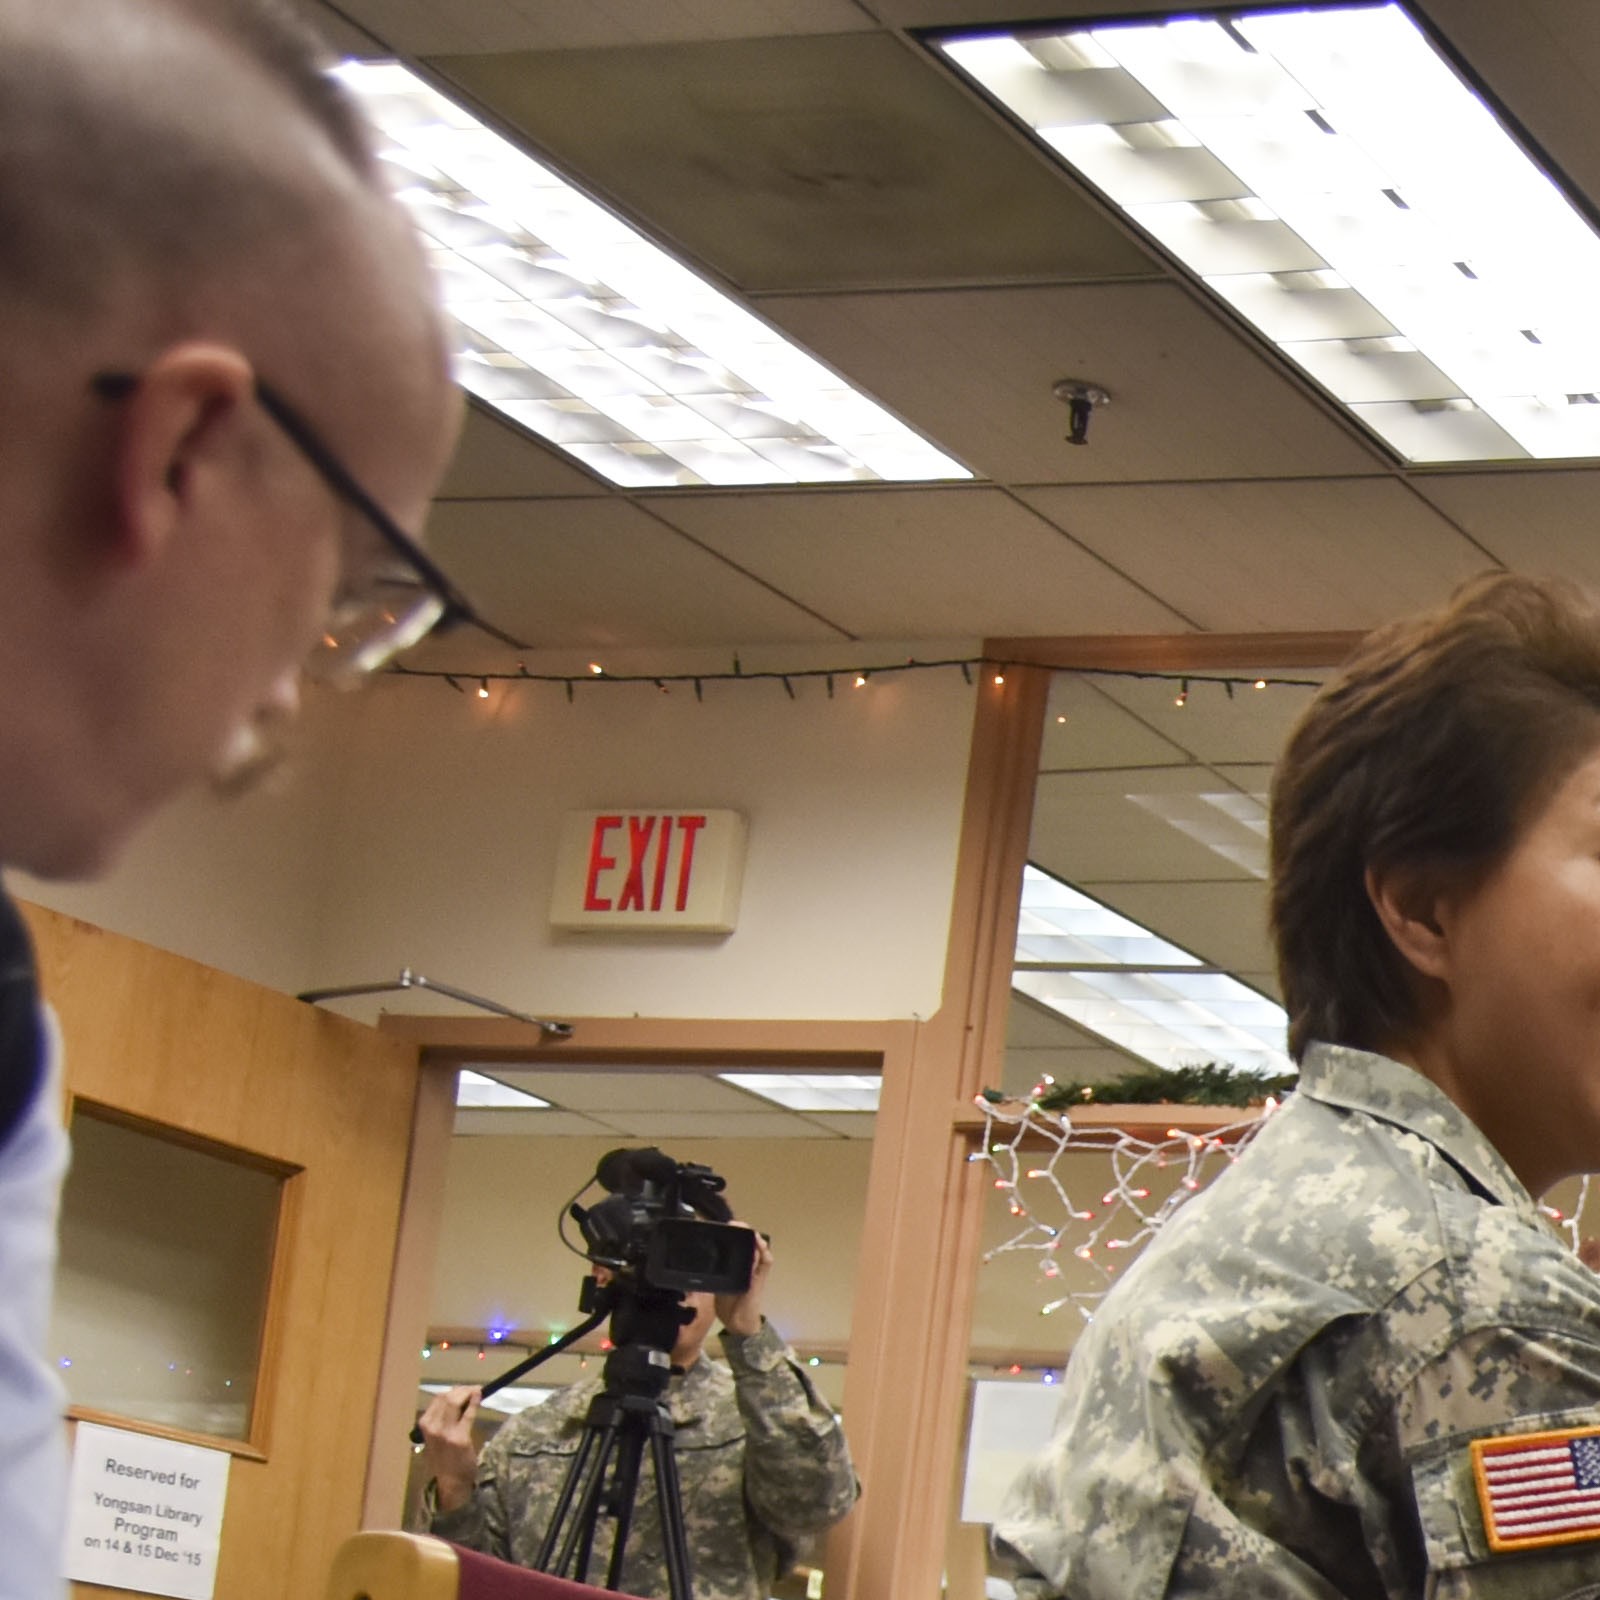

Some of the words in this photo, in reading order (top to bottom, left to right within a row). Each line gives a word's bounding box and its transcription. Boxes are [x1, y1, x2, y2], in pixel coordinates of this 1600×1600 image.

[584, 816, 707, 912] EXIT
[105, 1458, 176, 1486] Reserved
[180, 1473, 201, 1490] for
[93, 1491, 153, 1515] Yongsan
[155, 1503, 203, 1528] Library
[113, 1517, 178, 1543] Program
[84, 1536, 101, 1549] on
[105, 1538, 119, 1551] 14
[123, 1542, 133, 1554] &
[137, 1544, 151, 1558] 15
[154, 1546, 179, 1562] Dec
